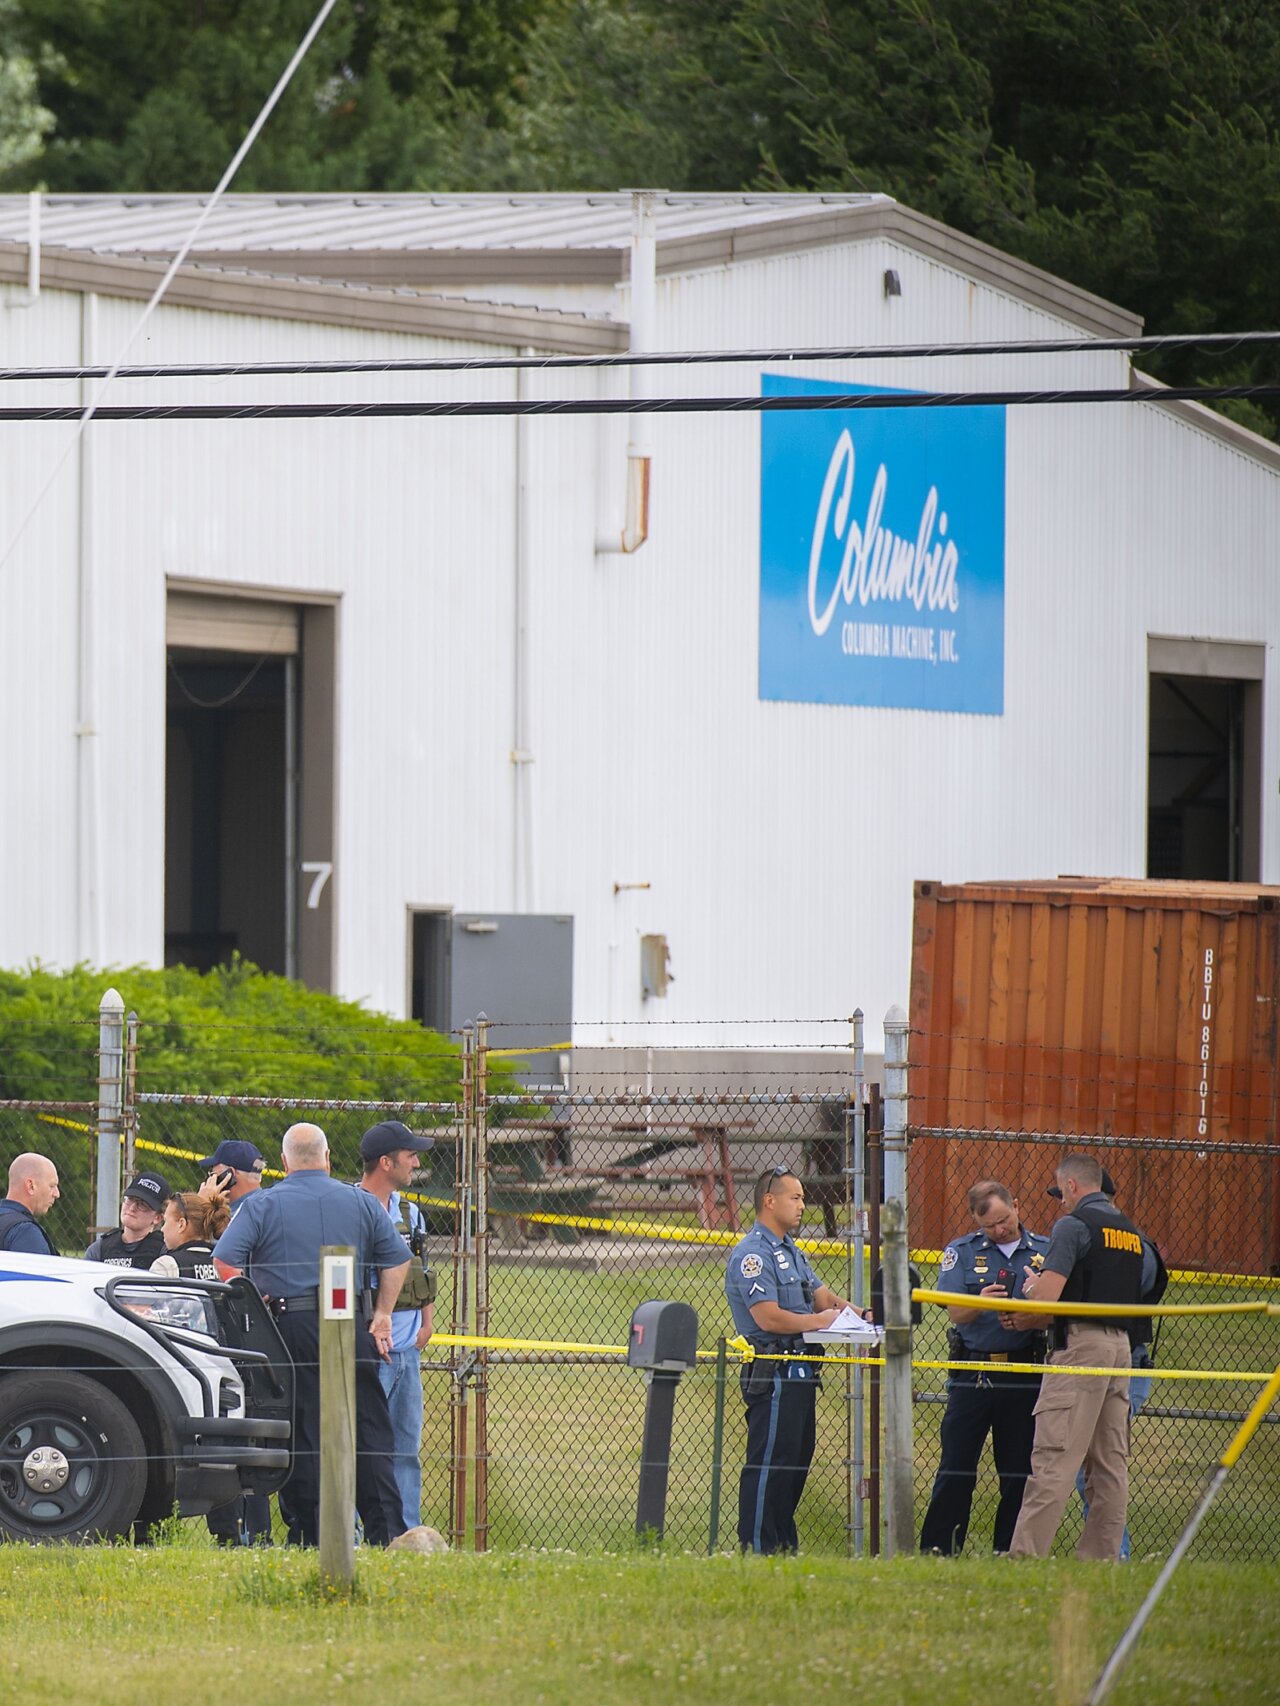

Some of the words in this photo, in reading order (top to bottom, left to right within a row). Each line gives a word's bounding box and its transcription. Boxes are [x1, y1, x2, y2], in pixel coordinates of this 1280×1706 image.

[808, 427, 959, 636] Columbia
[841, 621, 891, 657] COLUMBIA
[891, 624, 937, 665] MACHINE,
[939, 629, 959, 662] INC.
[301, 862, 332, 909] 7
[1201, 948, 1214, 1021] BBTU
[137, 1179, 161, 1194] POLICE
